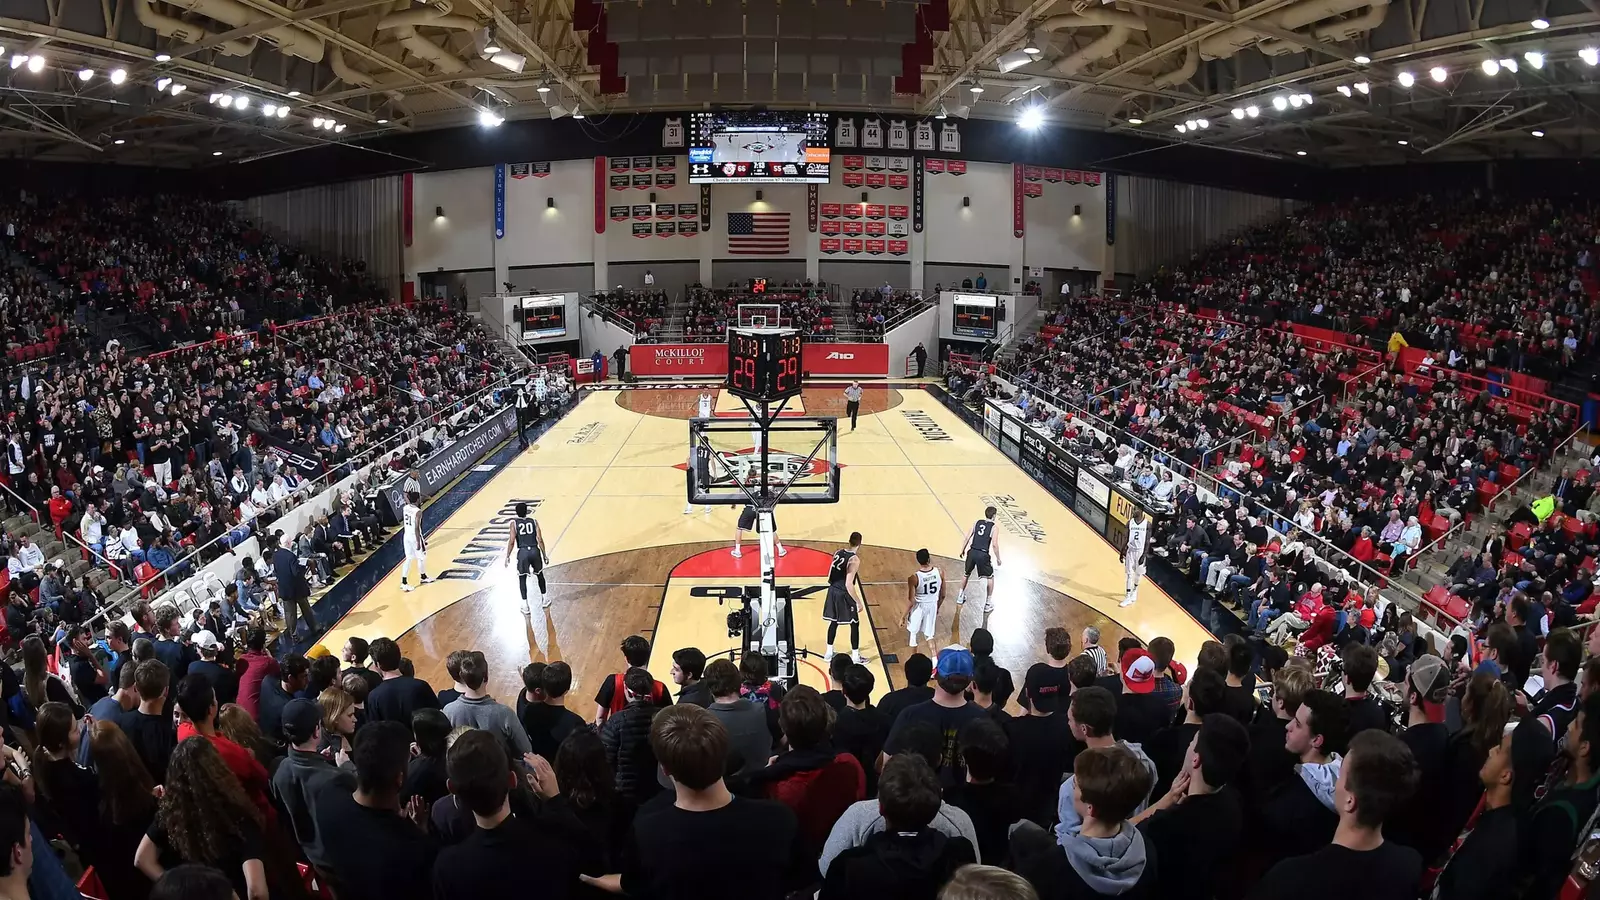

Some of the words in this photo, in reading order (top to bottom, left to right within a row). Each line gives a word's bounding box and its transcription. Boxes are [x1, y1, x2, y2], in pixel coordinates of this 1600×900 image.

[669, 128, 677, 137] 31
[842, 128, 850, 137] 21
[867, 129, 877, 138] 44
[894, 130, 903, 139] 10
[919, 131, 929, 140] 33
[947, 133, 953, 142] 11
[753, 283, 765, 293] 29
[655, 348, 705, 357] McKILLOP
[655, 358, 705, 366] COURT
[733, 356, 755, 389] 29
[777, 356, 797, 391] 29
[899, 409, 954, 442] DAVIDSON
[425, 423, 503, 486] EARNHARDTCHEVY.COM
[697, 449, 708, 459] 31
[518, 522, 534, 535] 20
[977, 524, 986, 536] 3
[1133, 531, 1140, 541] 2
[832, 554, 845, 571] 22
[923, 581, 938, 595] 15
